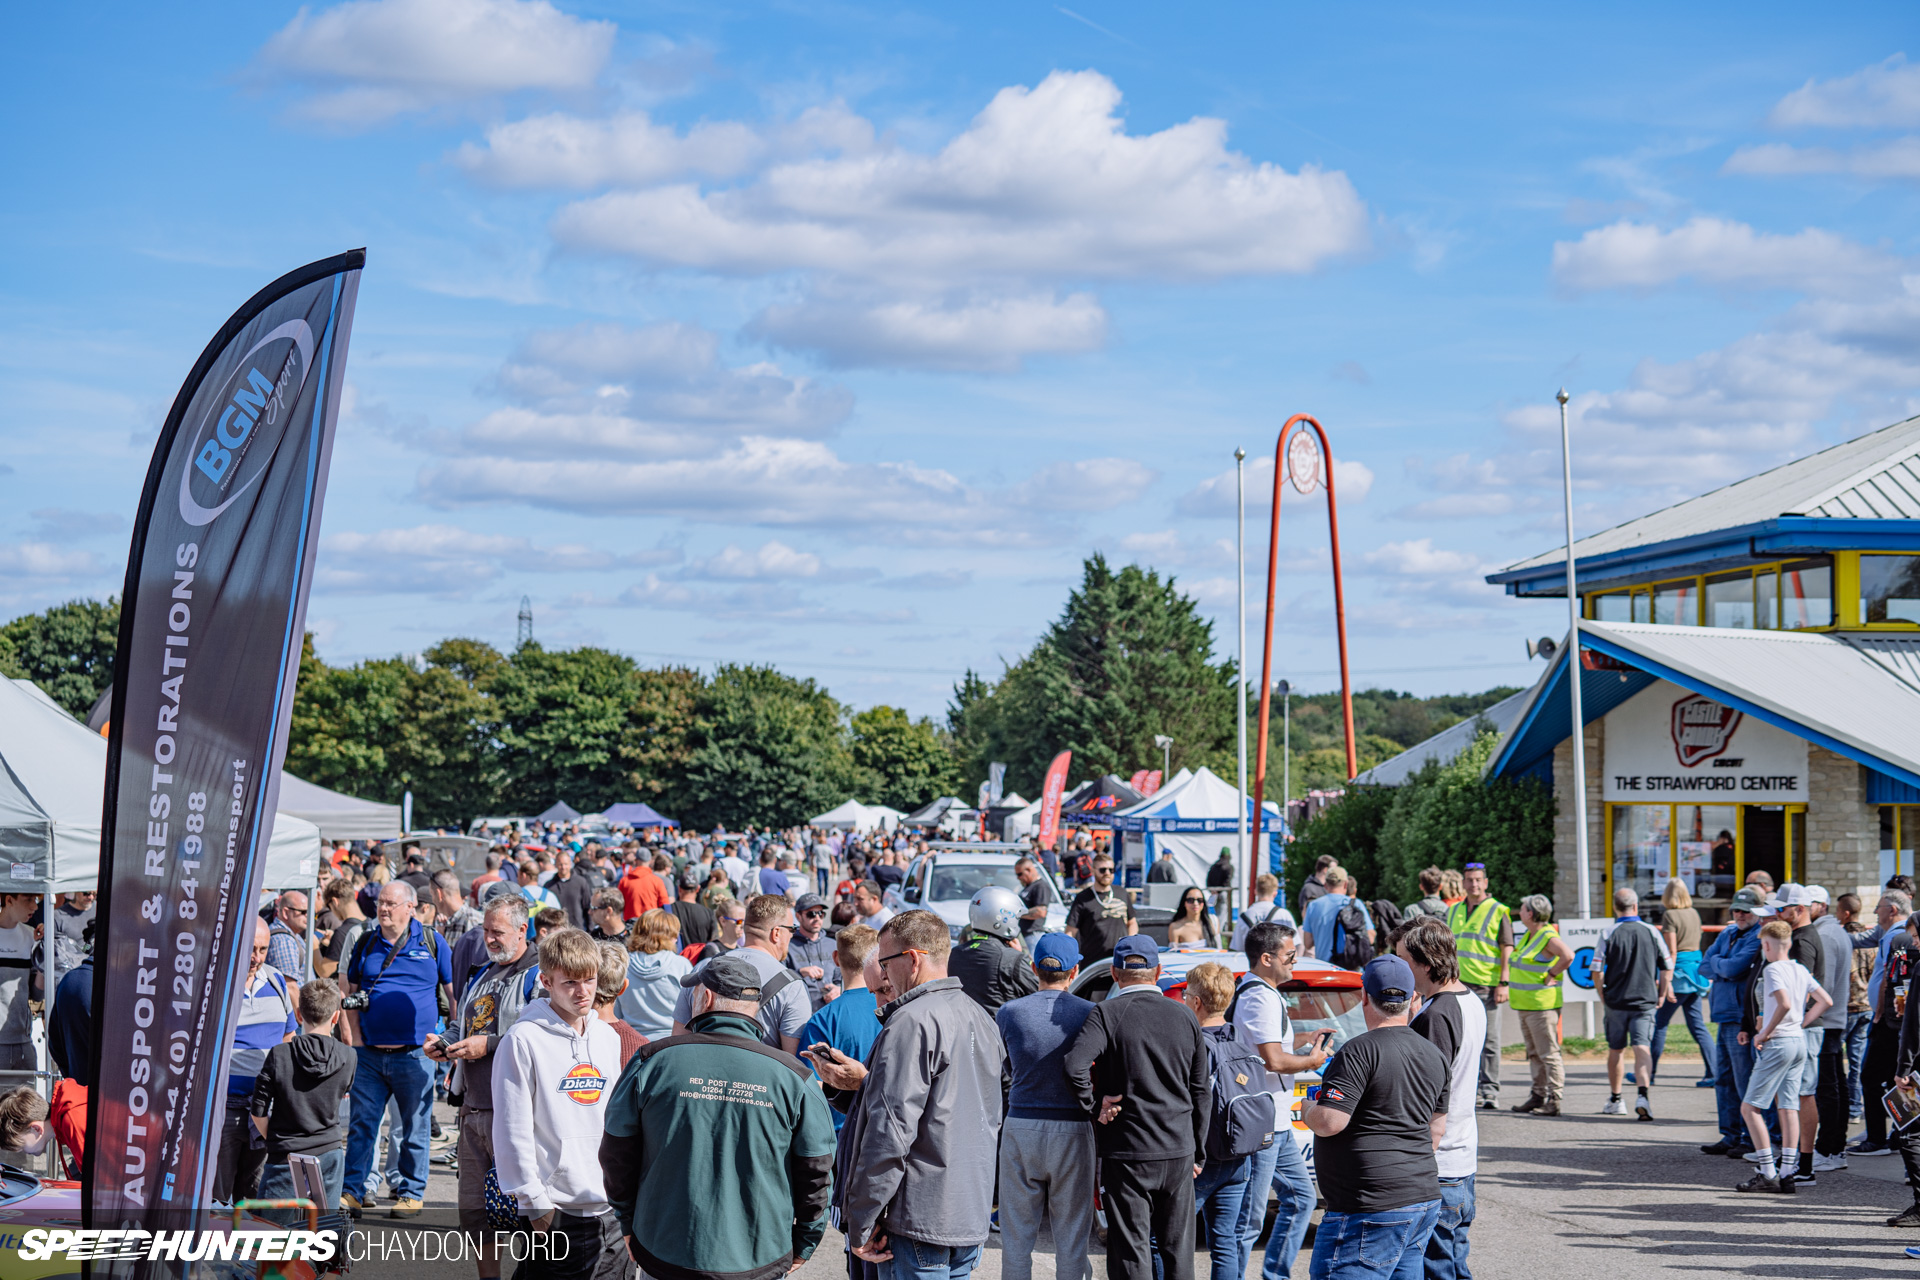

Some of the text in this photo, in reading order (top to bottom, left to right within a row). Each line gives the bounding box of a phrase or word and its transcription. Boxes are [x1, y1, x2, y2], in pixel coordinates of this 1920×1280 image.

[265, 349, 297, 425] Sport
[195, 367, 274, 484] BGM
[220, 422, 262, 491] Passionate about cars
[144, 542, 199, 877] RESTORATIONS
[1615, 776, 1798, 790] THE STRAWFORD CENTRE
[178, 792, 207, 920] 841988
[141, 893, 163, 924] &
[171, 758, 247, 1167] www.facebook.com/bgmsport
[172, 931, 196, 1016] 1280
[123, 938, 159, 1207] AUTOSPORT
[169, 1030, 190, 1076] (0)
[689, 1077, 767, 1093] RED POST SERVICES
[165, 1087, 179, 1130] 44
[679, 1090, 774, 1108] info@redpostservices.co.uk
[702, 1086, 754, 1098] 01264 772728
